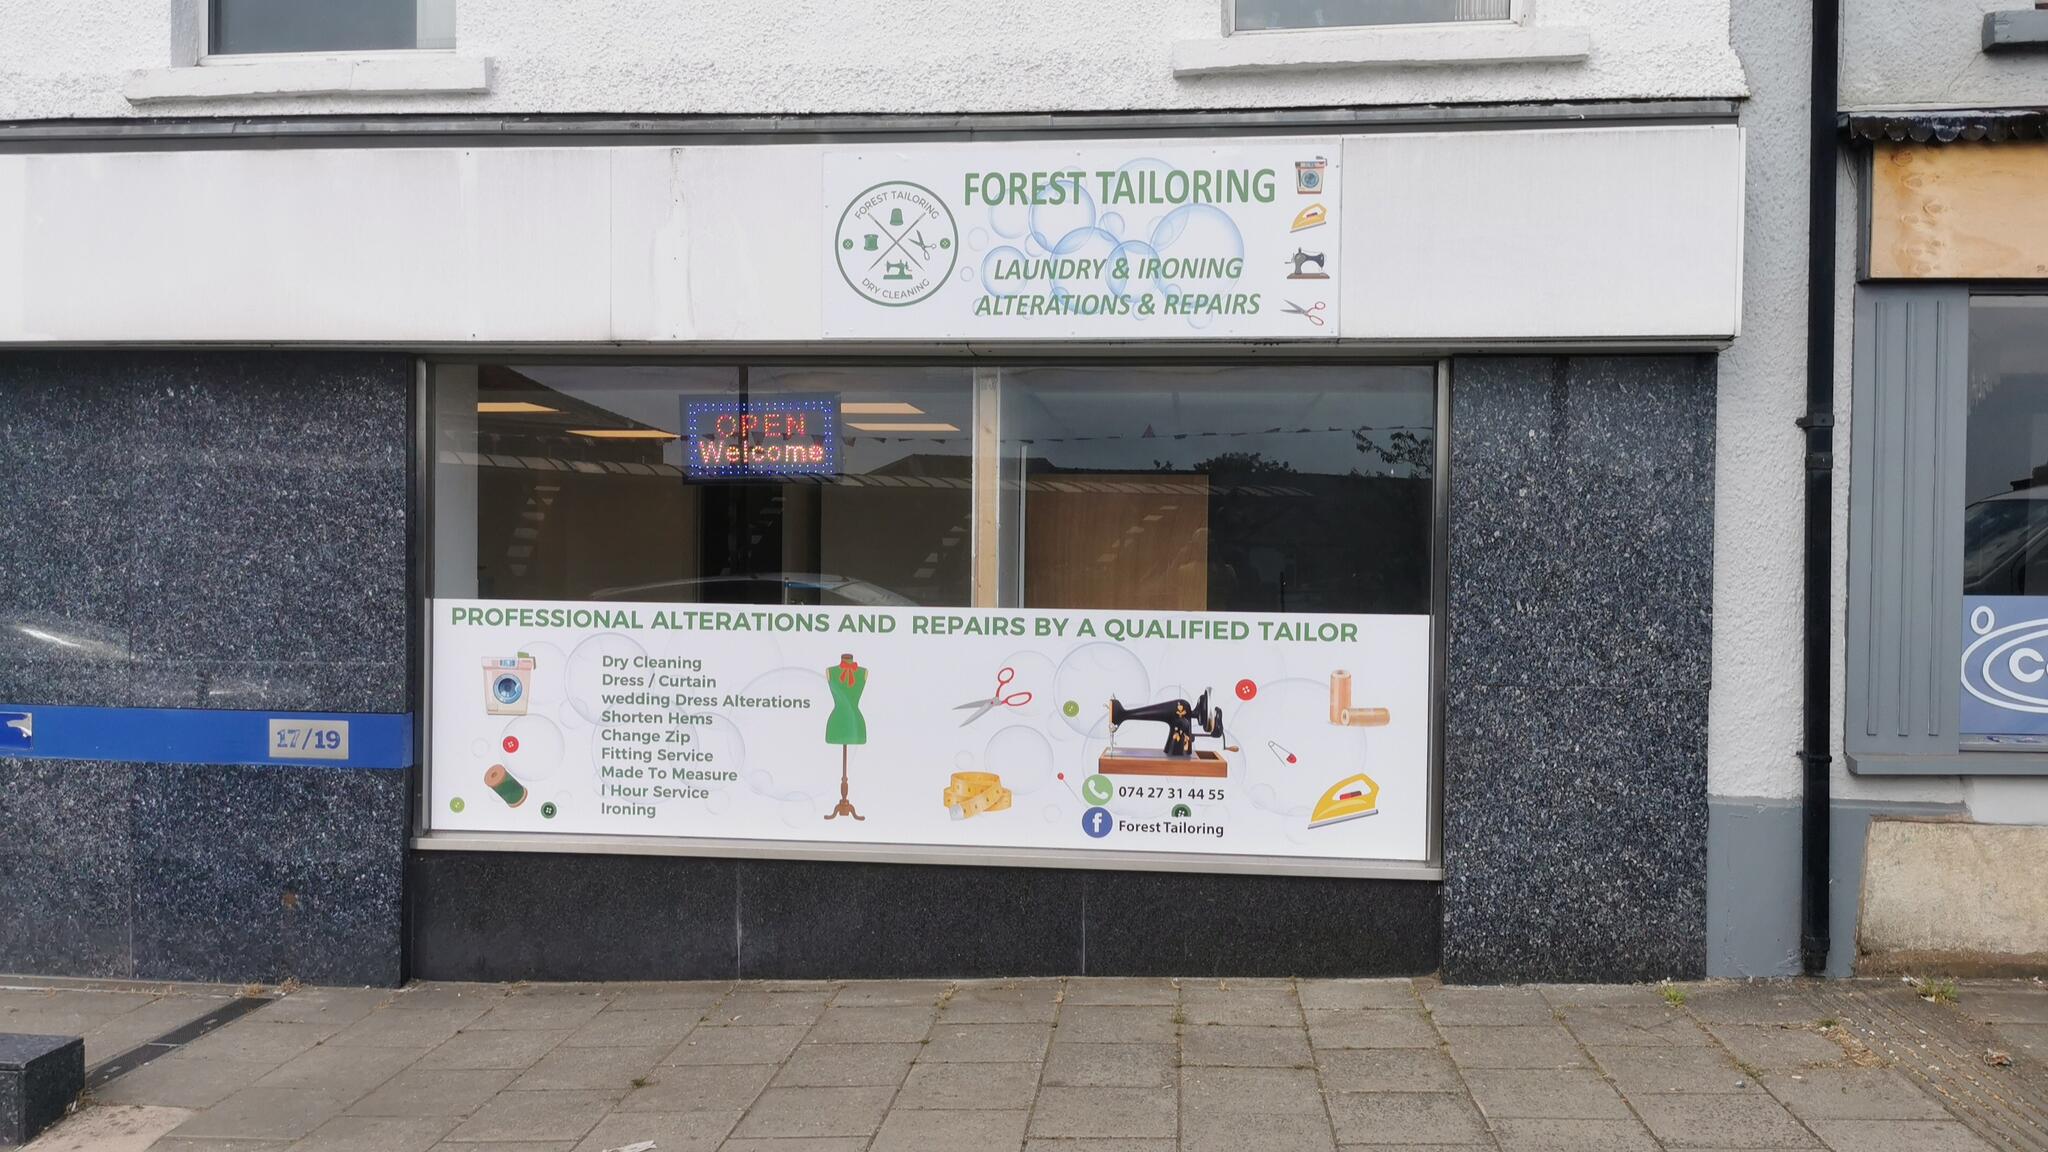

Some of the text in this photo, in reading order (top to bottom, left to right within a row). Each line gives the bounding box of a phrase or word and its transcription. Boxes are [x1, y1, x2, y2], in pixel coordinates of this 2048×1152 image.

[964, 169, 1276, 206] FOREST TAILORING
[854, 190, 940, 220] FOREST TAILORING
[994, 256, 1244, 281] LAUNDRY & IRONING
[862, 277, 930, 299] DRY CLEANING
[974, 292, 1261, 317] ALTERATIONS & REPAIRS
[716, 414, 807, 438] OPEN
[699, 440, 824, 464] Welcome
[451, 607, 1359, 643] PROFESSIONAL ALTERATIONS AND REPAIRS BY A QUALIFIED TAILOR
[602, 655, 702, 672] Dry Cleaning
[602, 674, 644, 687] Dress
[658, 675, 717, 688] Curtain
[601, 692, 811, 709] wedding Dress Alterations
[601, 711, 713, 725] Shorten Hems
[277, 728, 341, 750] 17/19
[601, 729, 691, 745] Change Zip
[601, 747, 714, 763] Fitting Service
[601, 766, 738, 781] Made To Measure
[610, 784, 649, 798] Hour
[653, 785, 709, 799] Service
[601, 803, 656, 819] Ironing
[1119, 821, 1224, 838] Forest Tailoring
